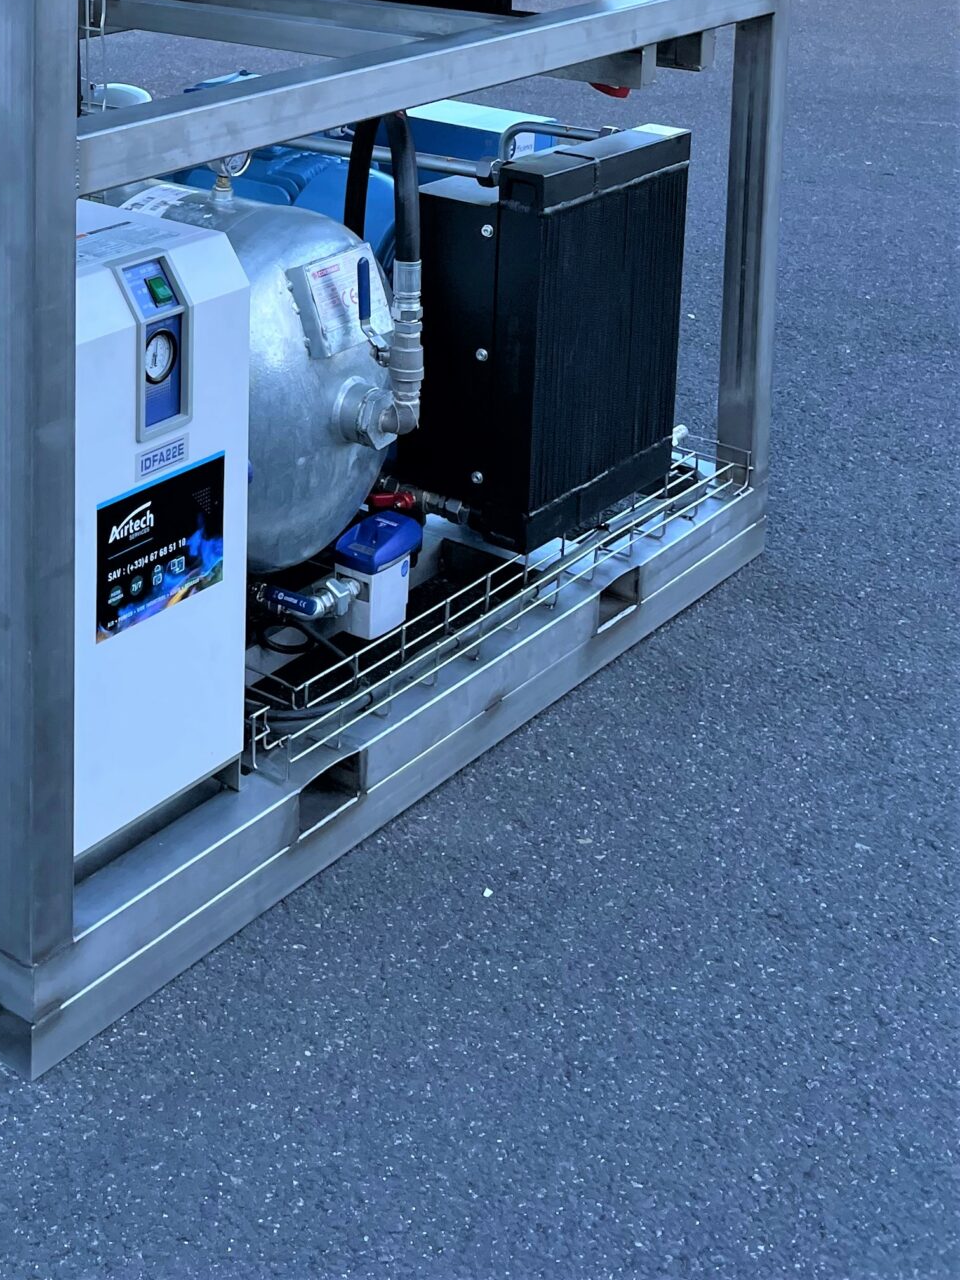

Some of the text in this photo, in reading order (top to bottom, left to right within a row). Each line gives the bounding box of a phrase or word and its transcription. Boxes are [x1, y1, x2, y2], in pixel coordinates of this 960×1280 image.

[140, 442, 185, 473] IDFA22E
[108, 501, 154, 544] Airtech
[108, 568, 122, 582] SAV
[150, 550, 158, 562] 67
[168, 542, 177, 553] 51
[178, 537, 186, 549] 10
